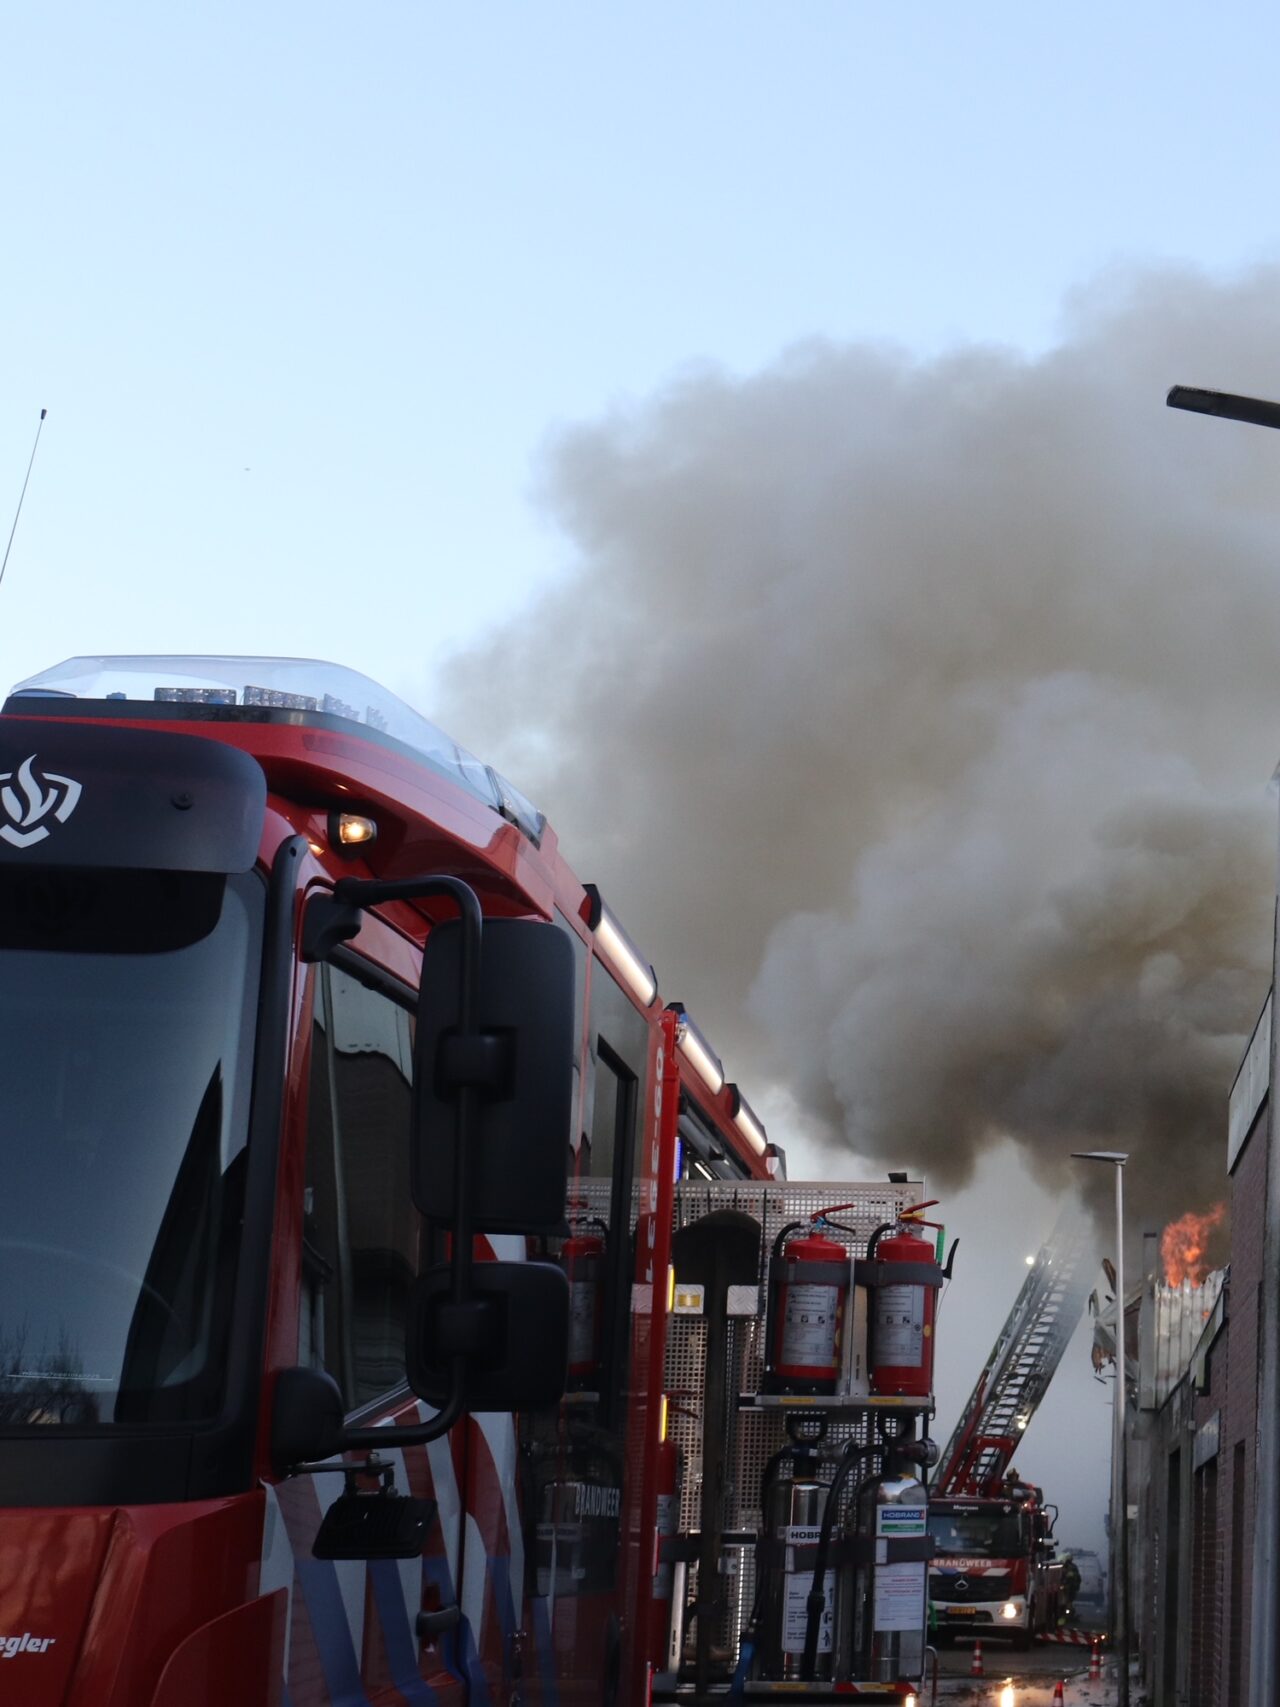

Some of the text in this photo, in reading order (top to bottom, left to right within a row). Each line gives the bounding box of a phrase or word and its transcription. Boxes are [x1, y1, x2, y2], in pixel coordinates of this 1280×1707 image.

[646, 1047, 664, 1283] 09-3931
[575, 1484, 620, 1517] BRANDWEER
[933, 1559, 992, 1567] BRANDWEER
